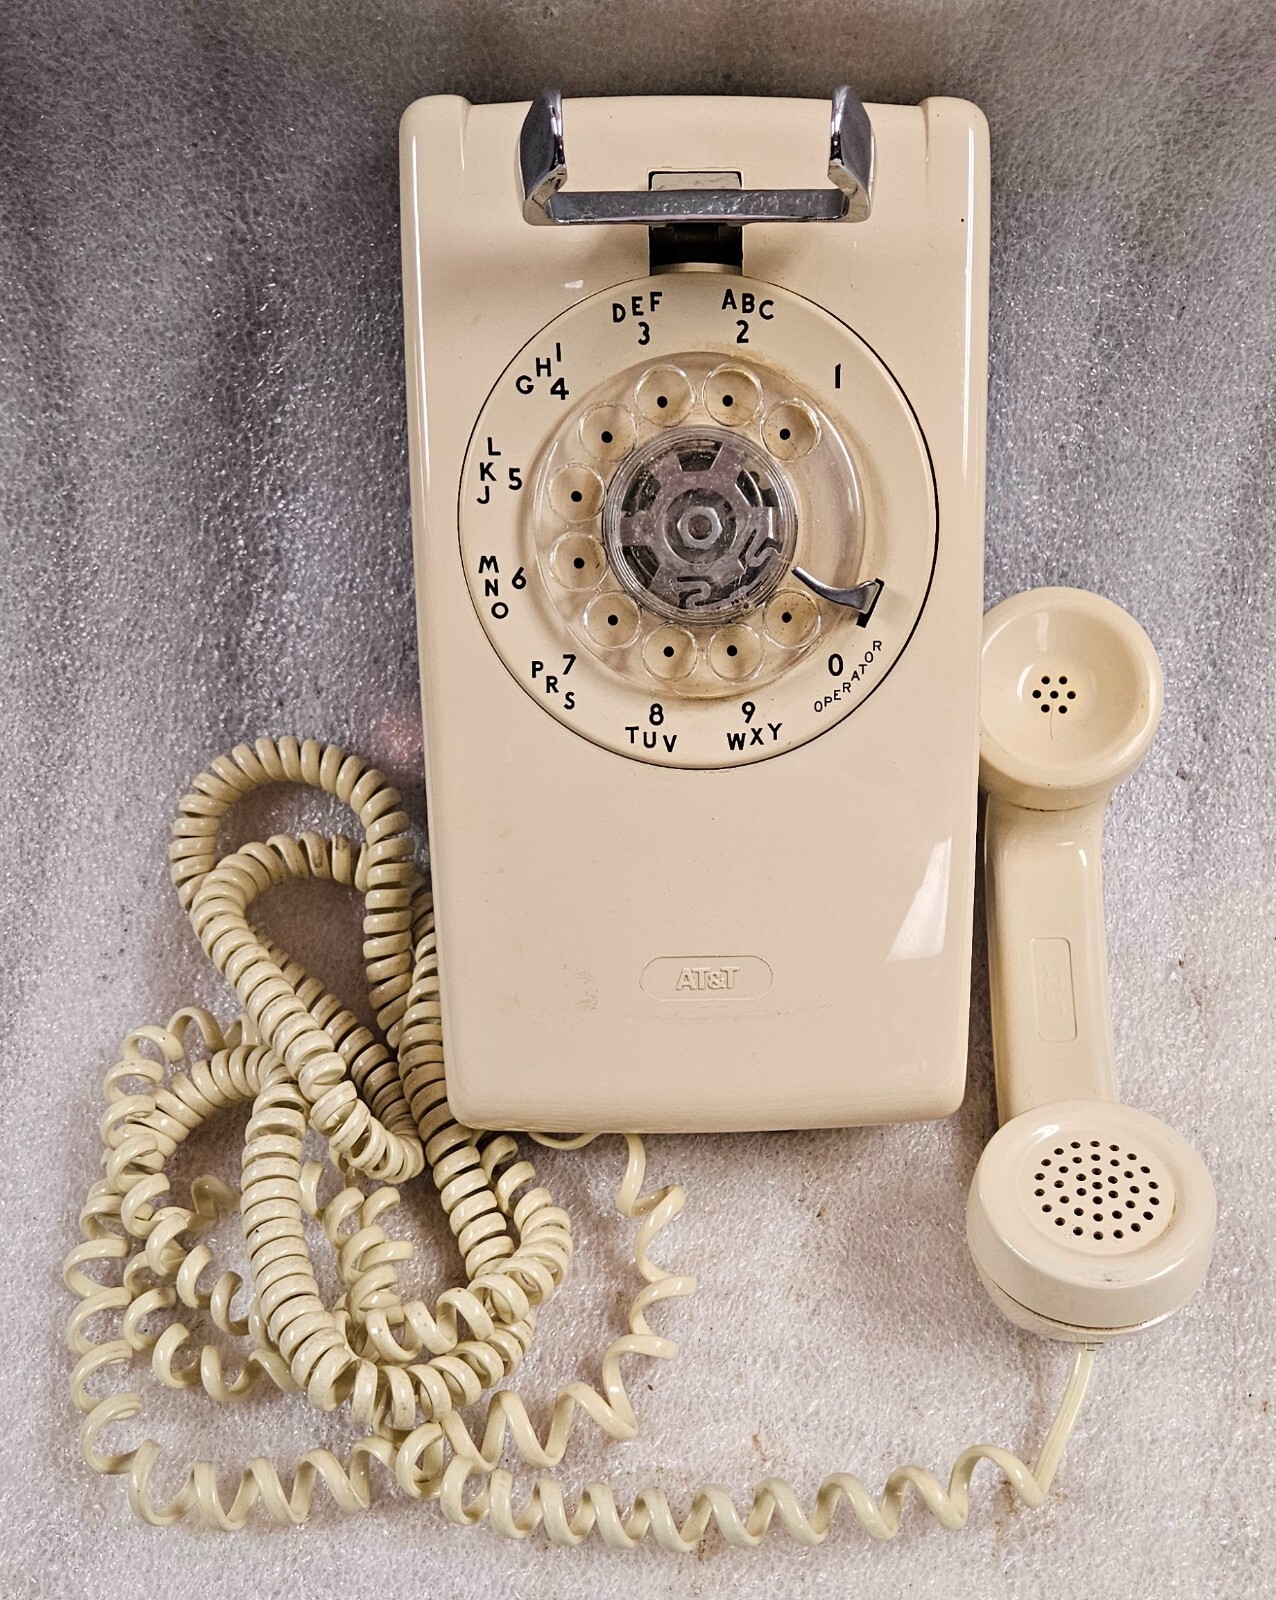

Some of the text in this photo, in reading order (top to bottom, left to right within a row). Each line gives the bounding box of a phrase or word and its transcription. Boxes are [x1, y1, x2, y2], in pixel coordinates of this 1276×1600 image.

[611, 291, 663, 323] DEF
[721, 288, 775, 321] ABC
[637, 321, 651, 346] 3
[735, 319, 749, 344] 2
[834, 363, 842, 389] 1
[549, 377, 570, 401] 4
[508, 467, 523, 491] 5
[511, 566, 527, 590] 6
[562, 653, 577, 676] 7
[813, 640, 883, 713] OPERATOR
[828, 653, 844, 677] 0
[531, 660, 576, 710] PRS
[648, 702, 665, 726] 8
[741, 701, 756, 724] 9
[624, 725, 678, 753] TUV
[726, 722, 784, 751] WXY
[675, 966, 740, 991] AT&T
